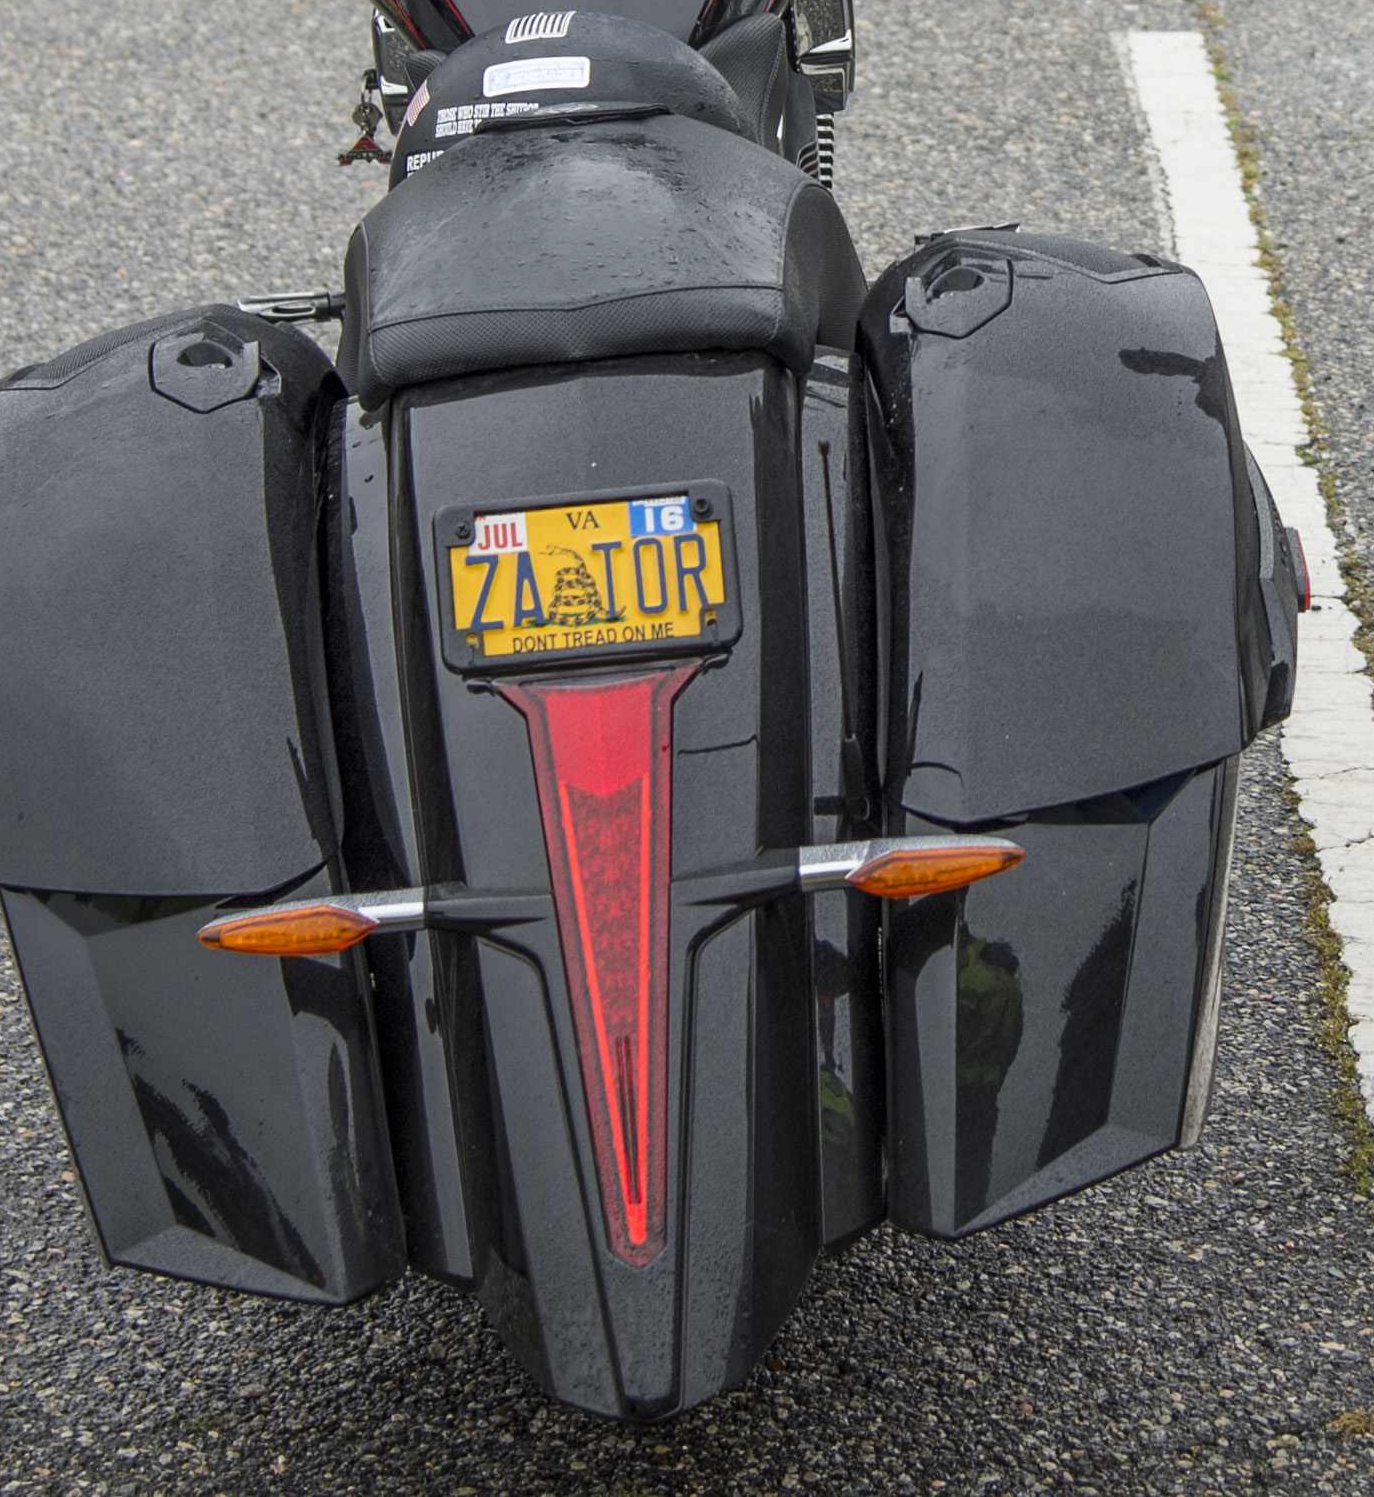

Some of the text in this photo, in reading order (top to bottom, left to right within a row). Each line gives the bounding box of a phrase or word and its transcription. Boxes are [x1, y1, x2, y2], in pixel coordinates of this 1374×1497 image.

[490, 103, 506, 118] THE
[565, 510, 601, 530] VA
[644, 505, 685, 533] 16
[477, 522, 523, 550] JUL
[512, 622, 675, 654] DONT TREAD ON ME
